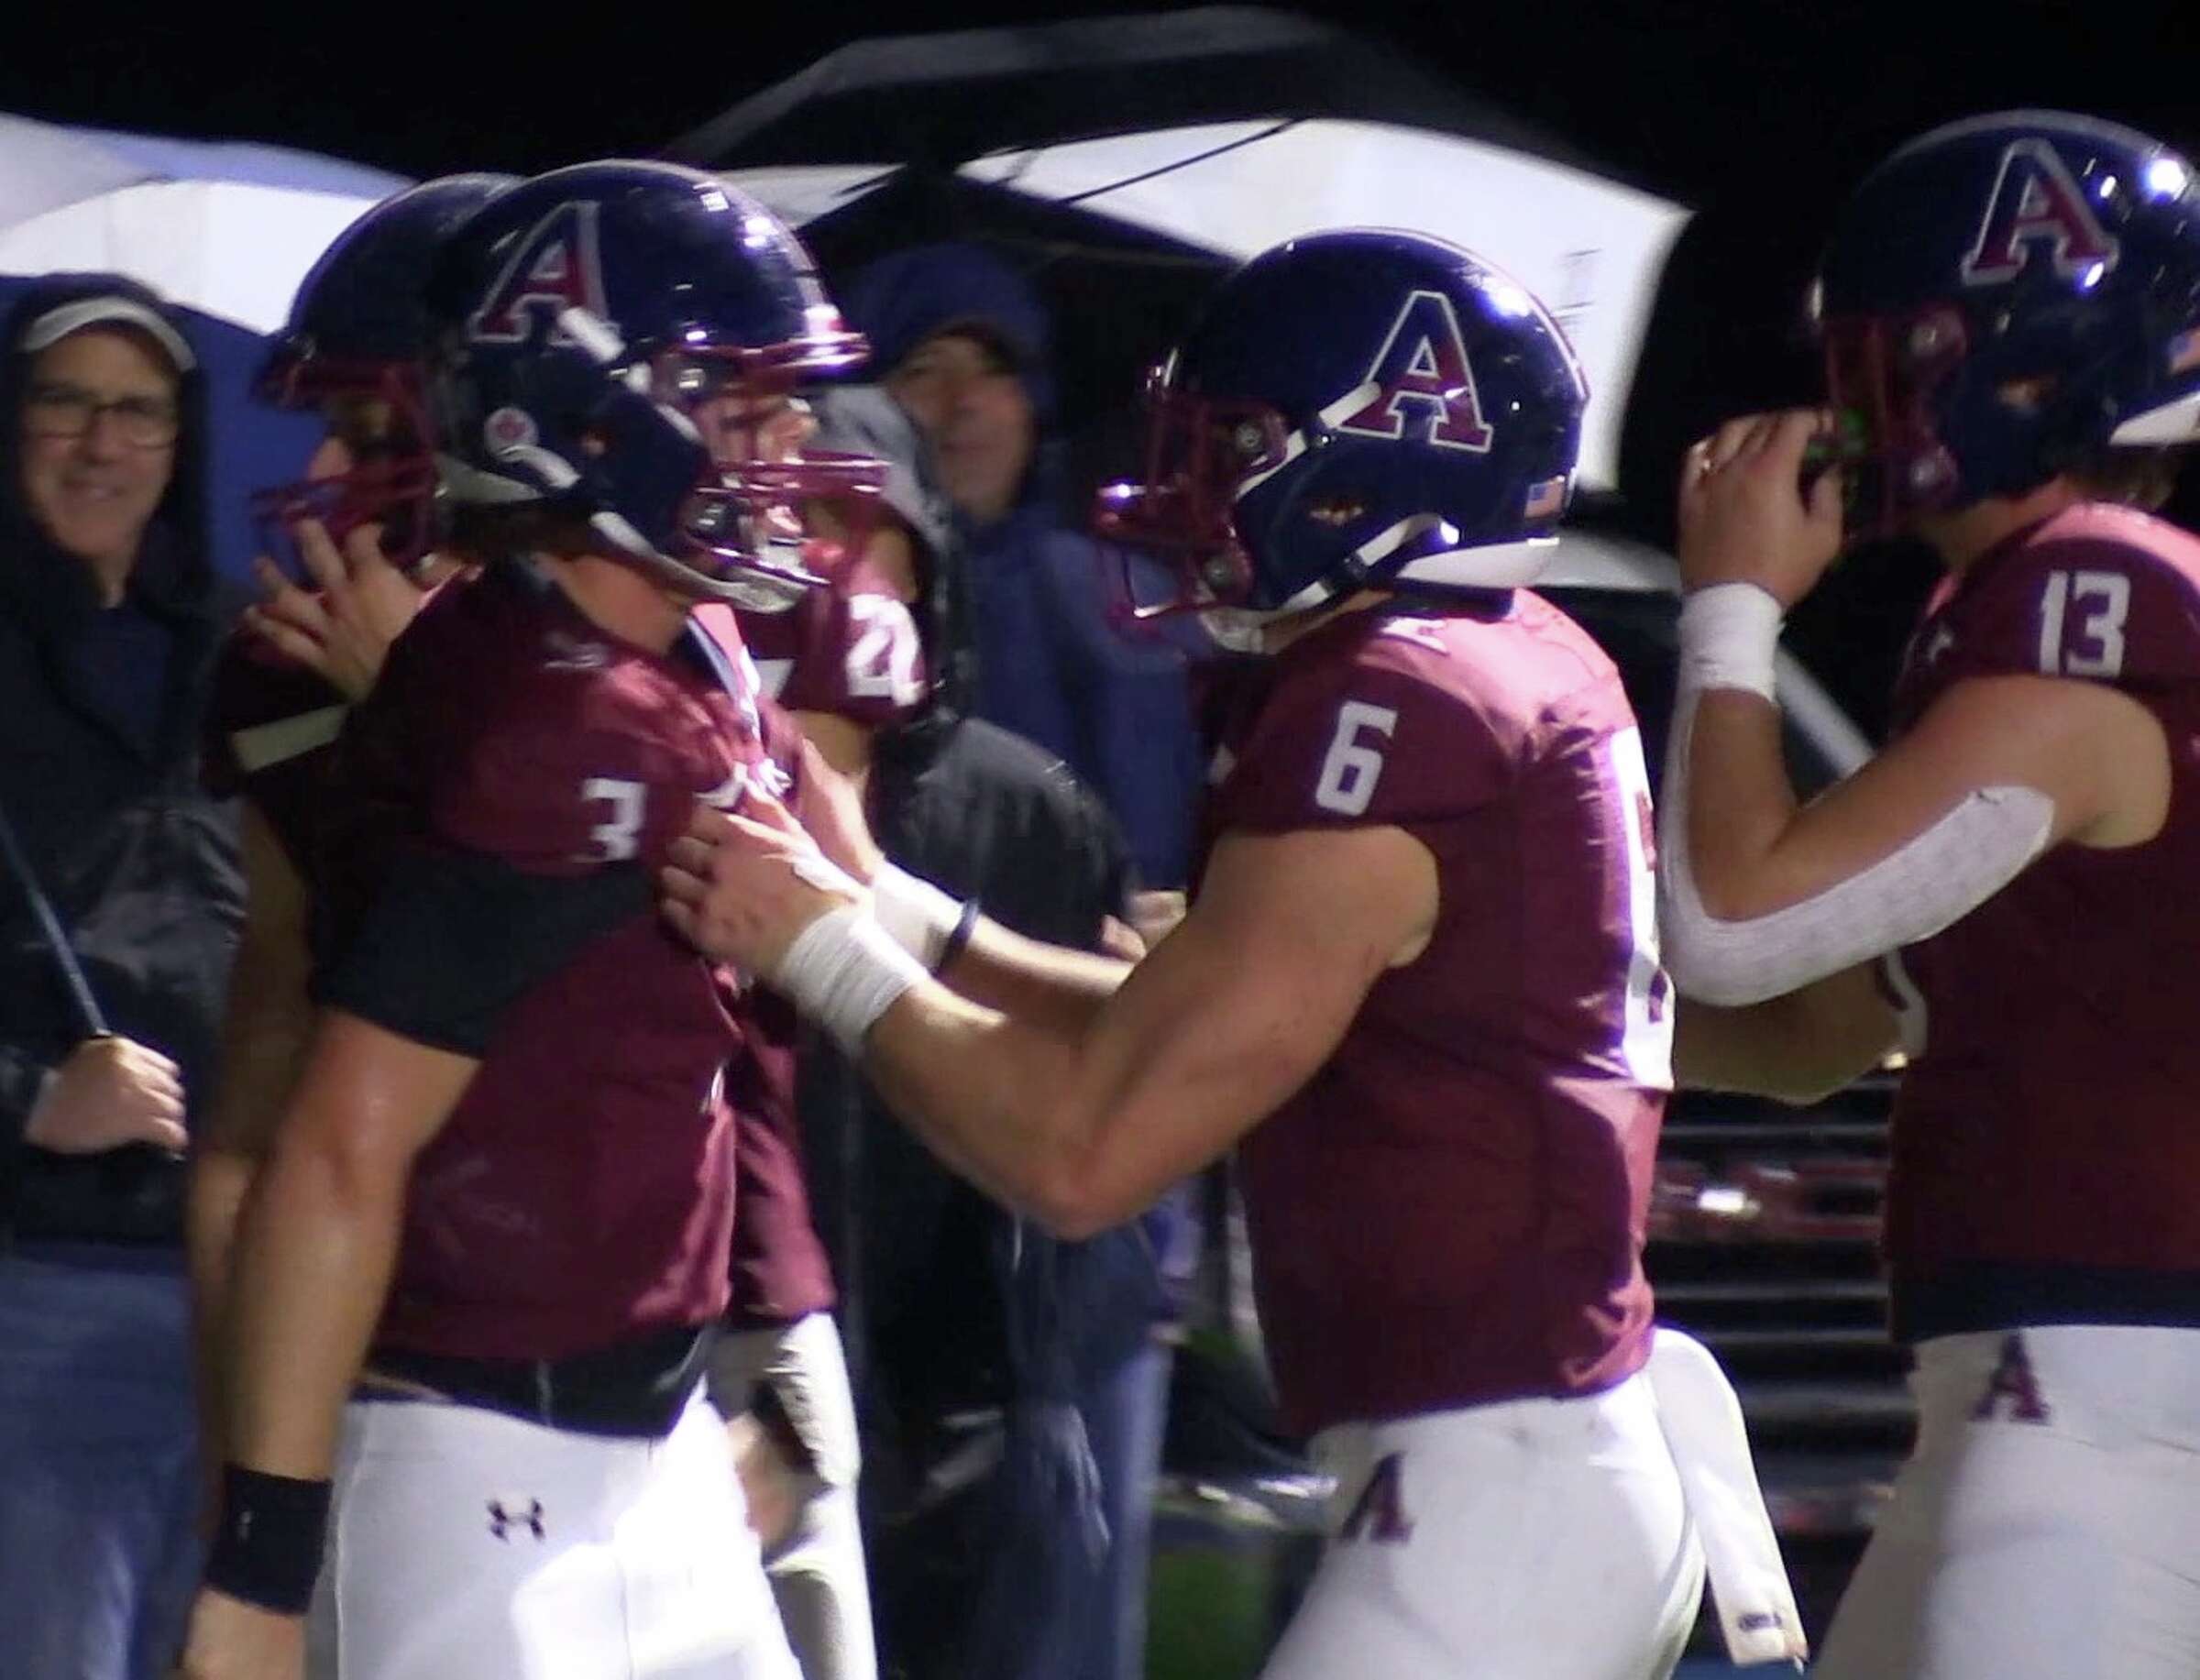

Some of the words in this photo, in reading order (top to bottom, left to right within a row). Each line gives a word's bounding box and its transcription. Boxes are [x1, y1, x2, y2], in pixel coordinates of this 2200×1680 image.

[1960, 137, 2119, 285] A
[466, 200, 623, 347] A
[1334, 290, 1493, 454] A
[2039, 569, 2131, 678] 13
[1315, 700, 1399, 817] 6
[581, 777, 645, 863] 3
[1971, 1331, 2052, 1426] A
[1338, 1450, 1418, 1543] A
